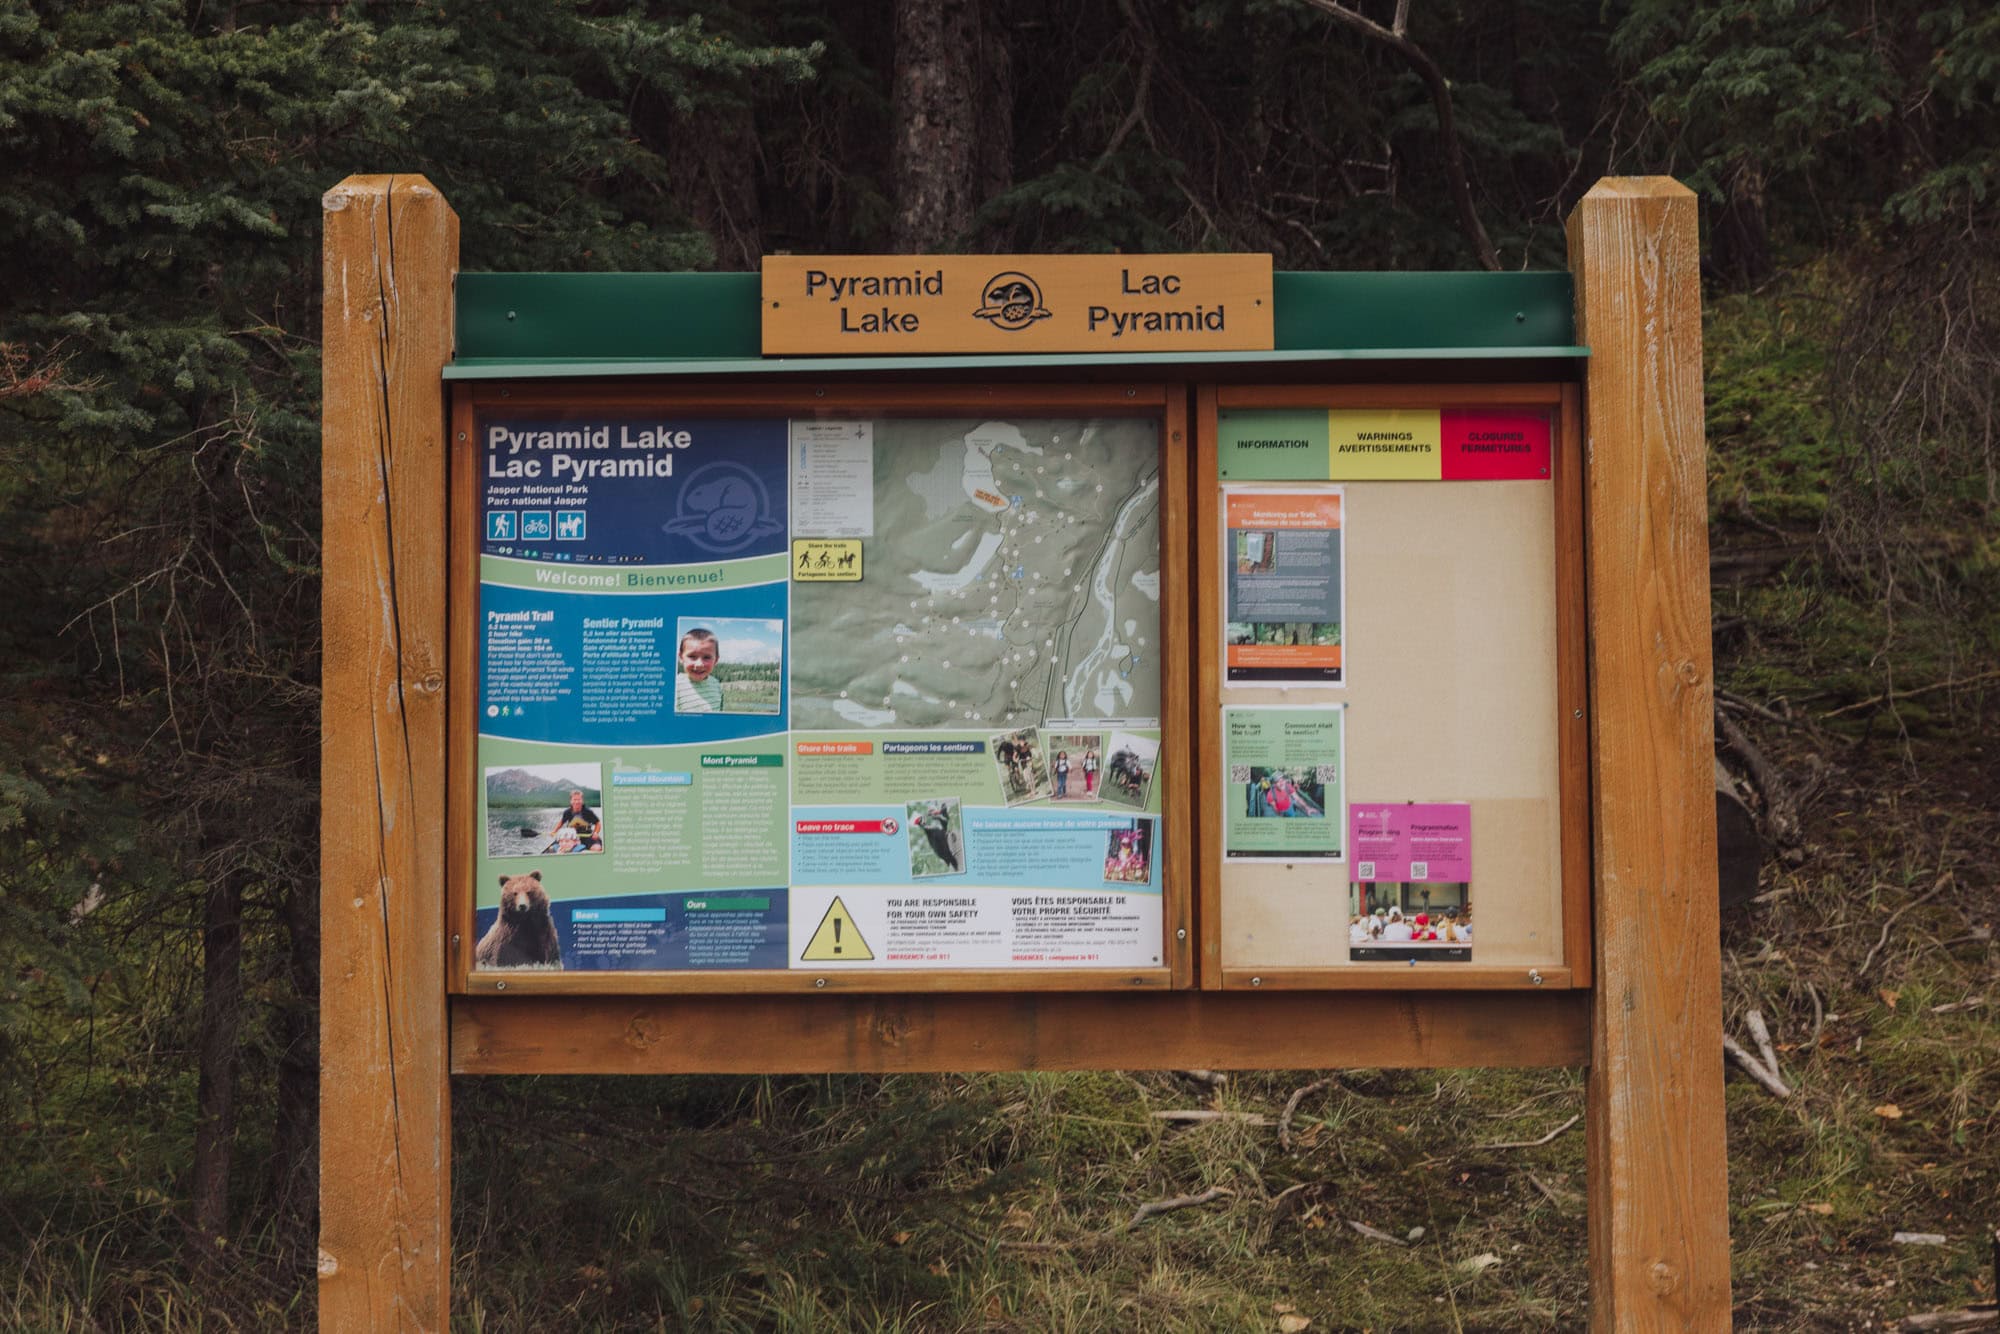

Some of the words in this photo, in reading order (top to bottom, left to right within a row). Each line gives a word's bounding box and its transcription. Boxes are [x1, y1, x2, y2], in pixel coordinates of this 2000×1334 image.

[806, 270, 943, 302] Pyramid
[1122, 269, 1181, 294] Lac
[840, 307, 920, 332] Lake
[1088, 305, 1225, 336] Pyramid
[489, 426, 610, 454] Pyramid
[620, 426, 692, 449] Lake
[1357, 432, 1413, 441] WARNINGS
[1469, 432, 1524, 441] CLOSURES
[1237, 439, 1309, 449] INFORMATION
[1338, 444, 1432, 453] AVERTISSEMENTS
[1461, 444, 1531, 453] FERMETURES
[488, 454, 542, 478] Lac
[552, 454, 673, 482] Pyramid
[488, 485, 520, 496] Jasper
[523, 485, 563, 495] National
[566, 485, 588, 495] Park
[487, 497, 509, 505] Parc
[512, 496, 551, 505] national
[554, 497, 588, 507] Jasper
[535, 569, 620, 587] Welcome!
[627, 568, 724, 587] Bienvenue!
[488, 610, 530, 624] Pyramid
[531, 610, 554, 622] Trail
[583, 617, 619, 629] Sentier
[621, 617, 664, 631] Pyramid
[798, 744, 821, 753] Share
[823, 744, 835, 753] the
[836, 744, 857, 752] trails
[883, 743, 929, 754] Partageons
[931, 743, 941, 752] les
[942, 744, 974, 752] sentiers
[703, 756, 724, 765] Mont
[725, 756, 758, 766] Pyramid
[614, 775, 647, 785] Pyramid
[797, 823, 821, 832] Leave
[822, 824, 833, 832] no
[834, 823, 855, 832] trace
[686, 900, 707, 909] Ours
[888, 899, 902, 907] YOU
[904, 899, 919, 907] ARE
[922, 899, 977, 907] RESPONSIBLE
[1012, 897, 1033, 905] VOUS
[1035, 895, 1055, 905] ÊTES
[1057, 896, 1113, 905] RESPONSABLE
[1115, 896, 1126, 905] DE
[949, 910, 979, 918] SAFETY
[1012, 907, 1036, 915] VOTRE
[1039, 907, 1070, 915] PROPRE
[1073, 905, 1111, 915] SÉCURITÉ
[575, 911, 599, 920] Bears
